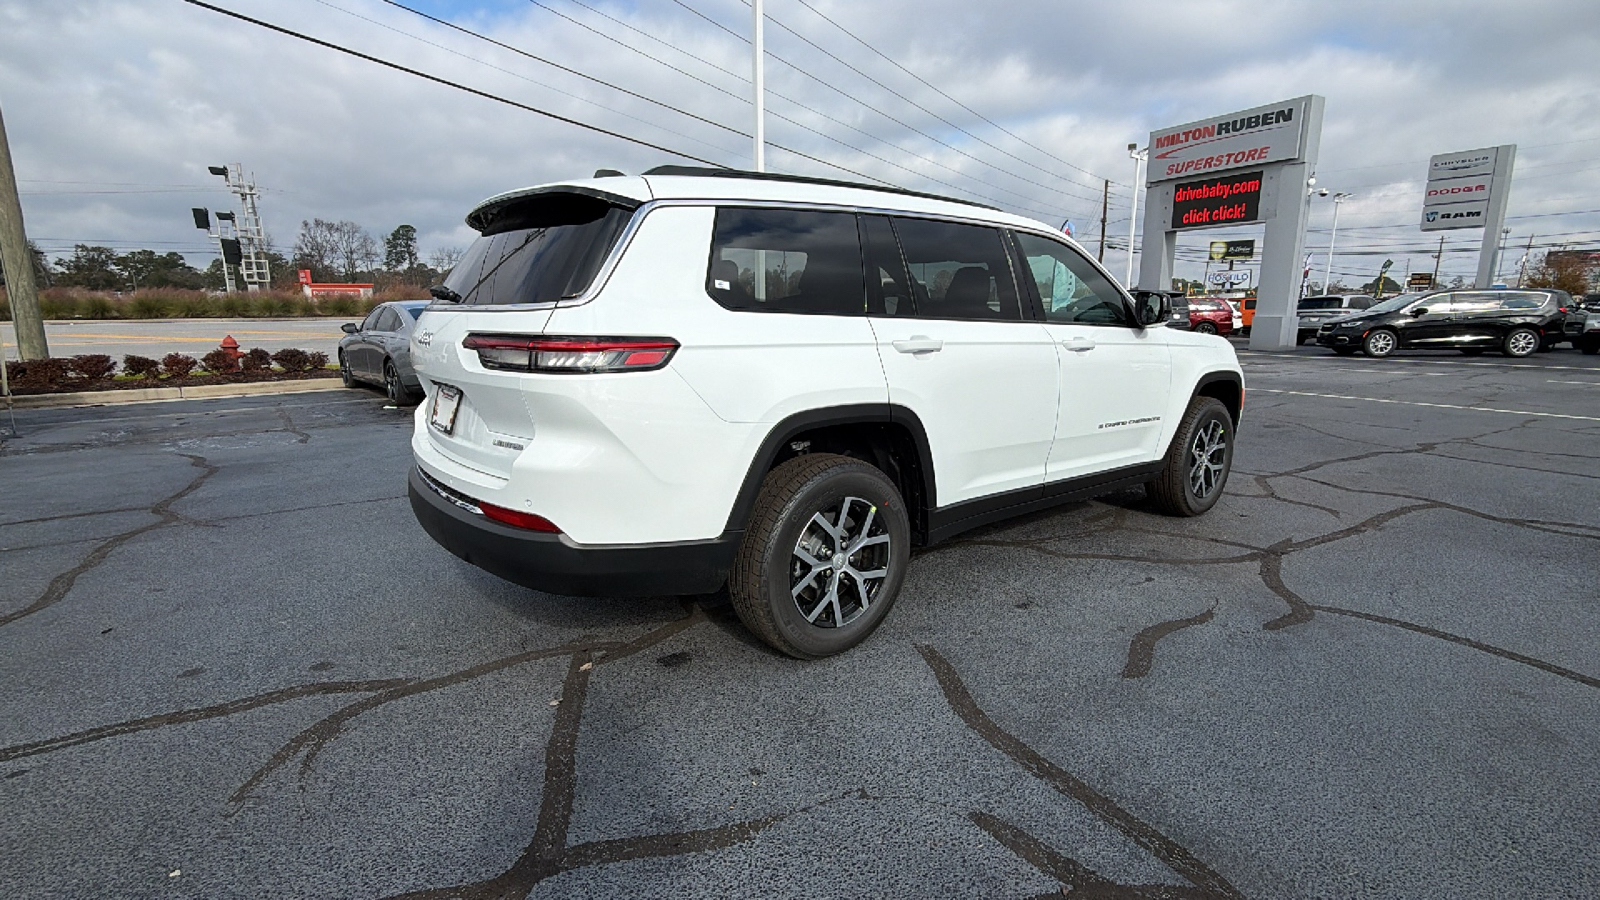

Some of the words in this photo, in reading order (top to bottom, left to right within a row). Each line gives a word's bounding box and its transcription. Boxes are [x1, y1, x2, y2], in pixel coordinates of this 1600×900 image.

[1166, 146, 1270, 176] SUPERSTORE
[1433, 156, 1489, 167] CHRYSLER
[1175, 180, 1259, 202] drivebaby.com
[1427, 184, 1486, 196] DODGE
[1182, 208, 1210, 224] click
[1212, 203, 1246, 220] click!
[1440, 211, 1481, 219] RAM
